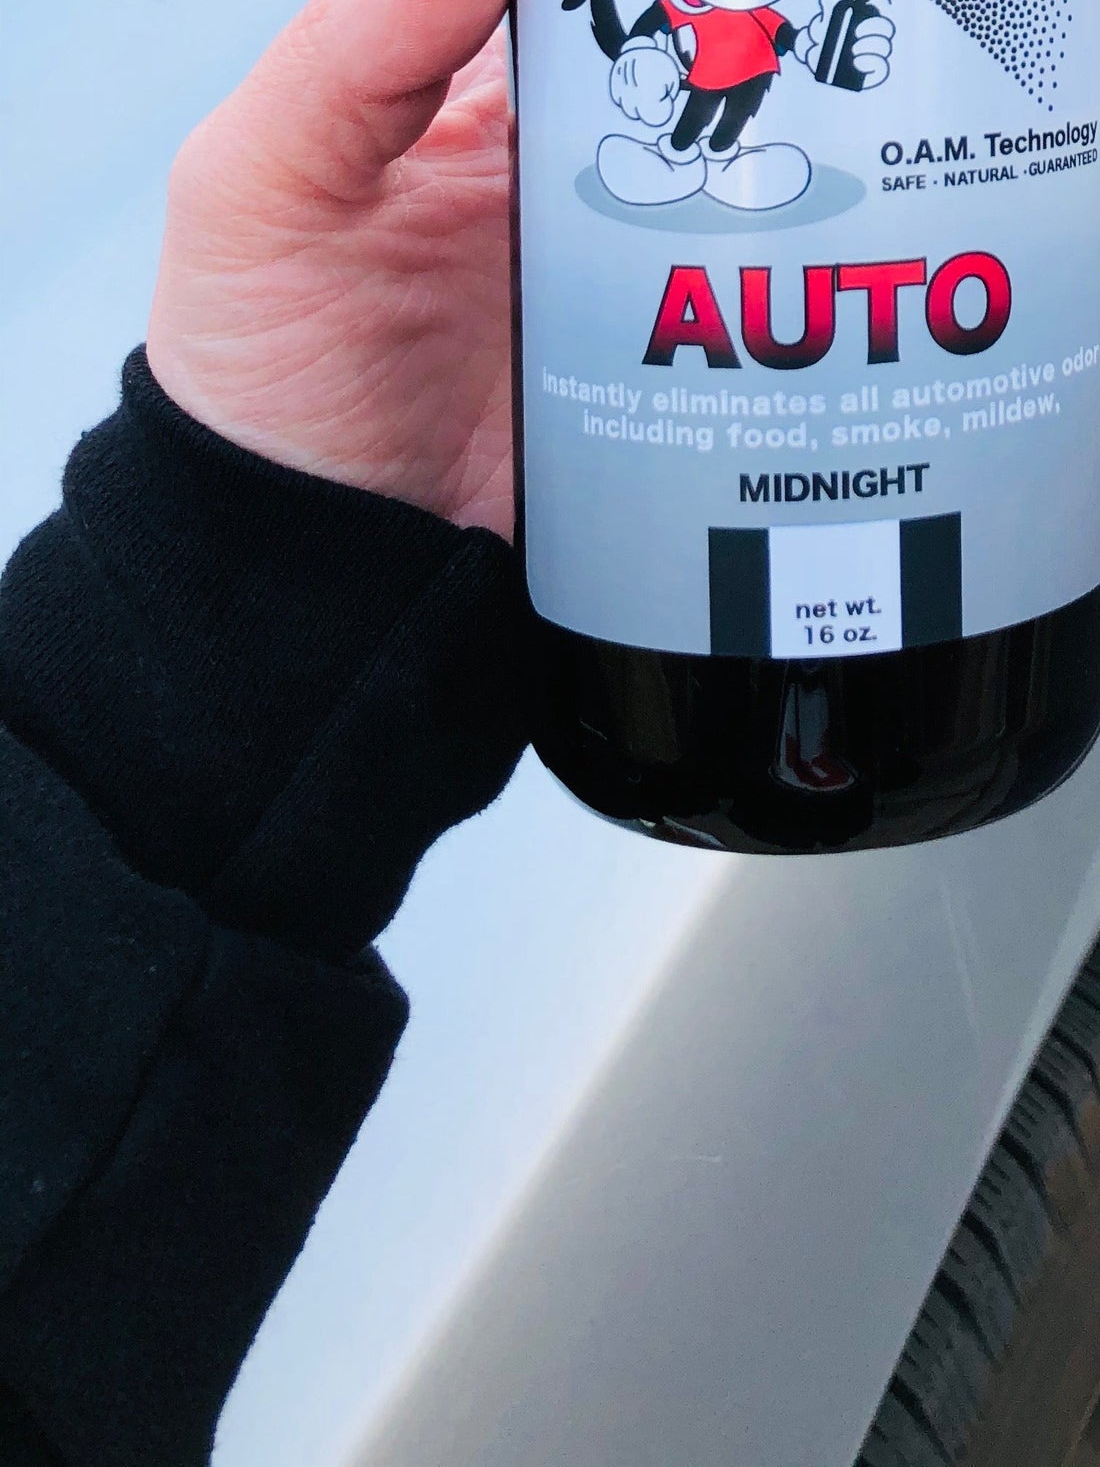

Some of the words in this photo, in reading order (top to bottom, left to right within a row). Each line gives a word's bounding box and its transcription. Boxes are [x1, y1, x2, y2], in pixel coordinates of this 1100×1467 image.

[881, 136, 976, 166] O.A.M.
[984, 120, 1098, 158] Technology
[882, 174, 926, 192] SAFE
[944, 165, 1018, 187] NATURAL
[641, 250, 1012, 370] AUTO
[542, 366, 642, 414] instantly
[653, 387, 826, 416] eliminates
[840, 386, 879, 413] all
[892, 362, 1056, 409] automotive
[1062, 344, 1100, 377] odor
[583, 408, 714, 452] including
[727, 421, 818, 452] food,
[832, 414, 950, 446] smoke,
[962, 392, 1061, 432] mildew,
[739, 462, 931, 503] MIDNIGHT
[796, 599, 837, 619] net
[845, 596, 882, 616] wt.
[804, 625, 835, 645] 16
[843, 626, 878, 643] oz.
